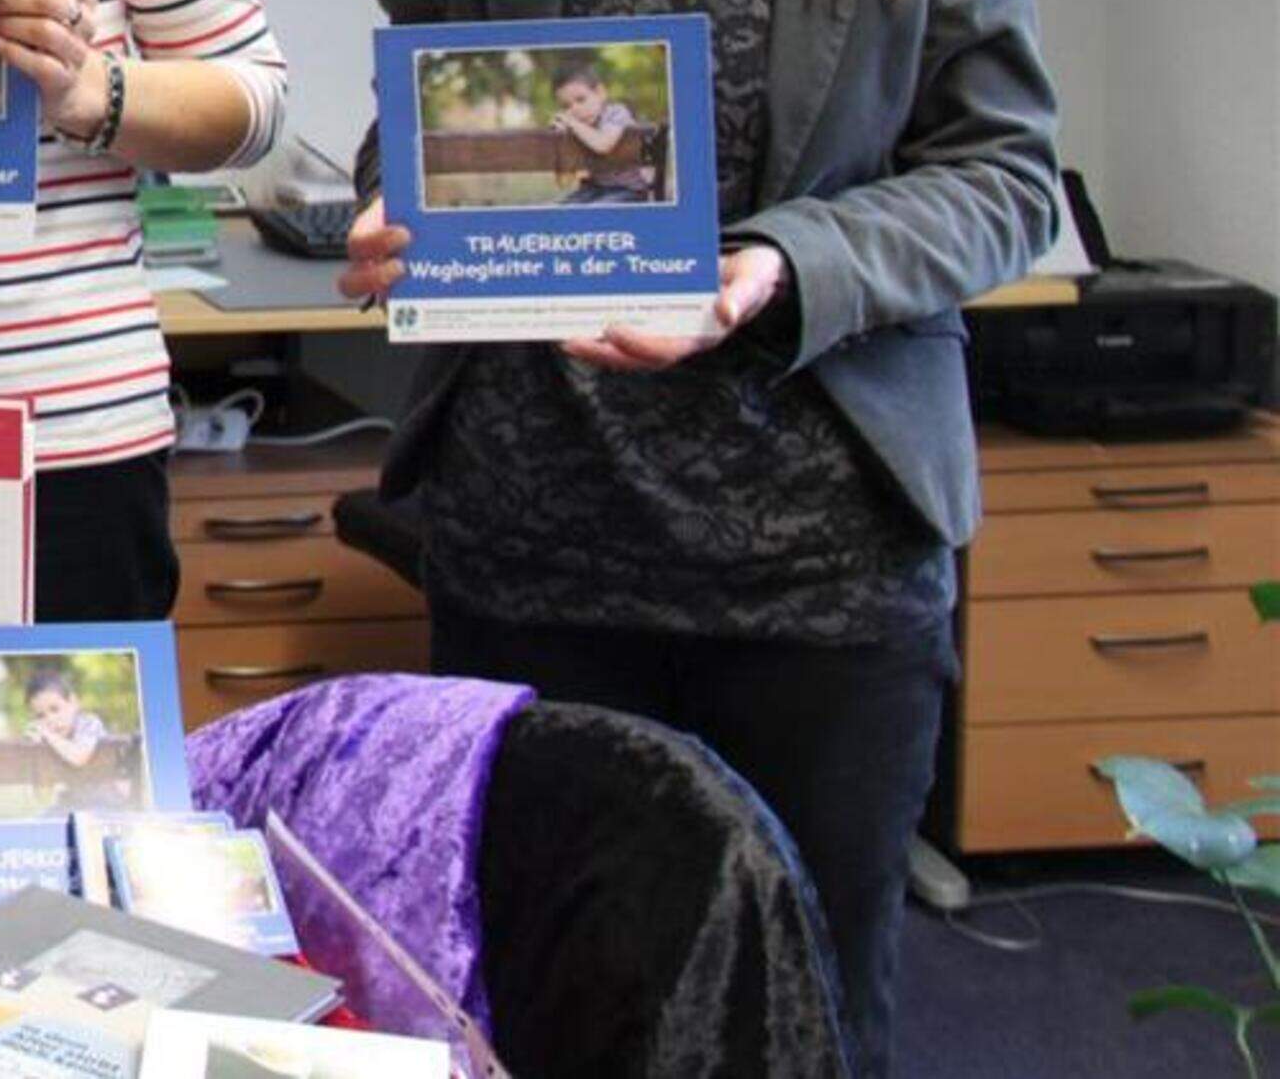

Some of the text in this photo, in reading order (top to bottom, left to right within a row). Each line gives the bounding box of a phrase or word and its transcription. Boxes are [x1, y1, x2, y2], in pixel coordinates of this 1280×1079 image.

[465, 232, 636, 254] TRAUERKOFFER
[409, 256, 697, 283] Wegbegleiter in der Trauer
